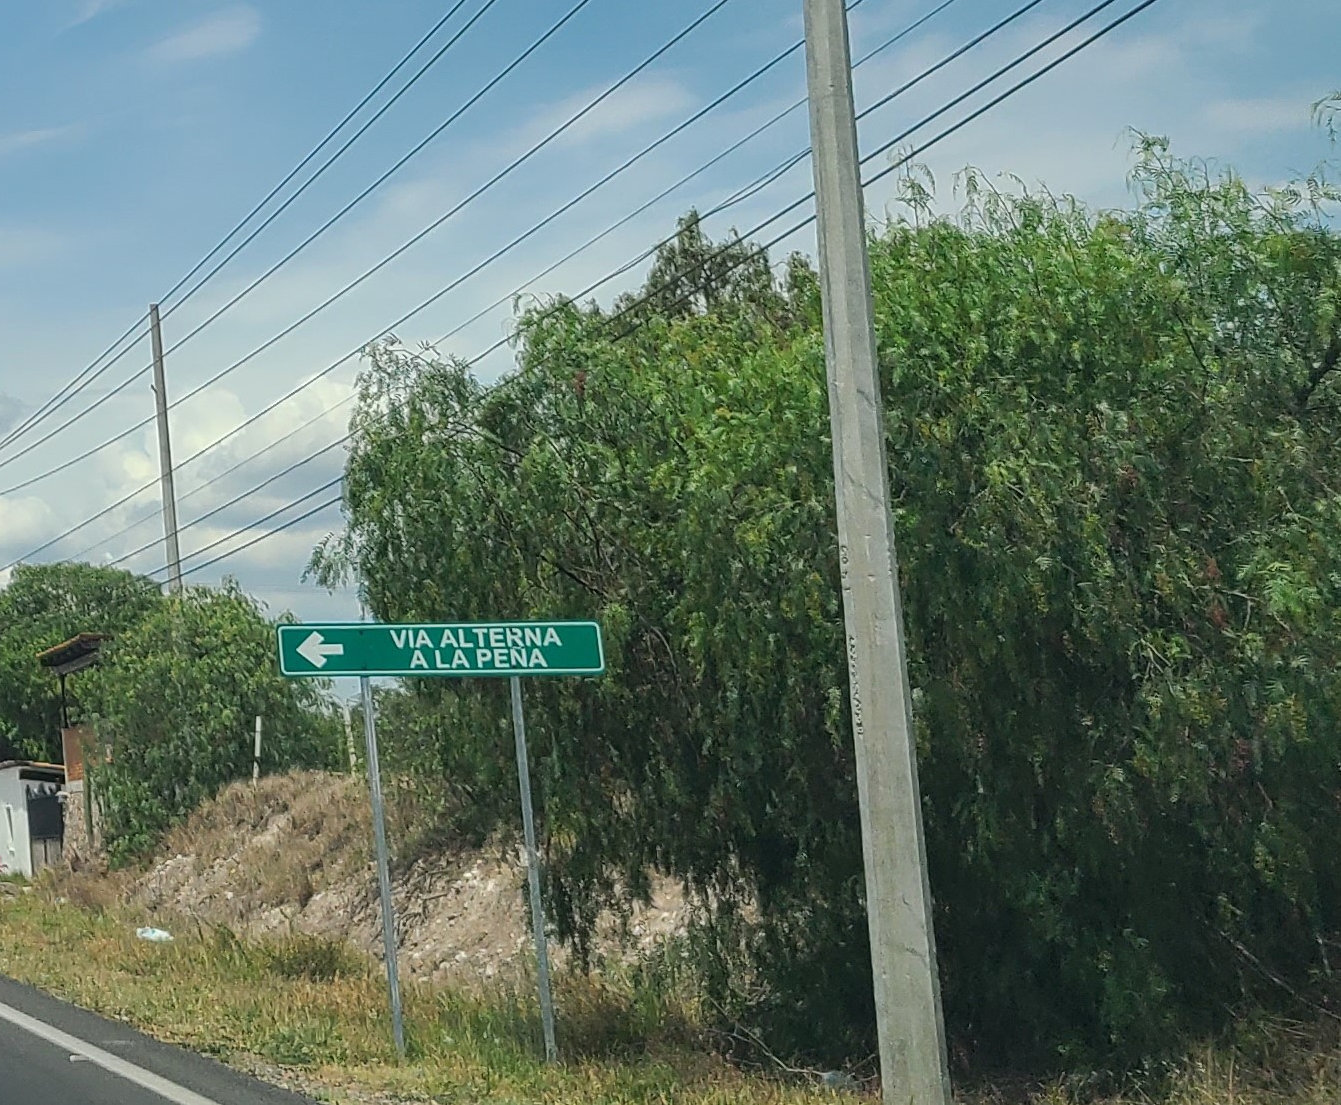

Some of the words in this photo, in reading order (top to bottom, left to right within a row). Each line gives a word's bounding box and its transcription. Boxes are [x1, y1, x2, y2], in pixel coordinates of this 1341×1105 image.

[439, 627, 563, 648] ALTERNA
[410, 650, 429, 669] A
[434, 649, 470, 669] LA
[475, 645, 549, 668] PEÑA
